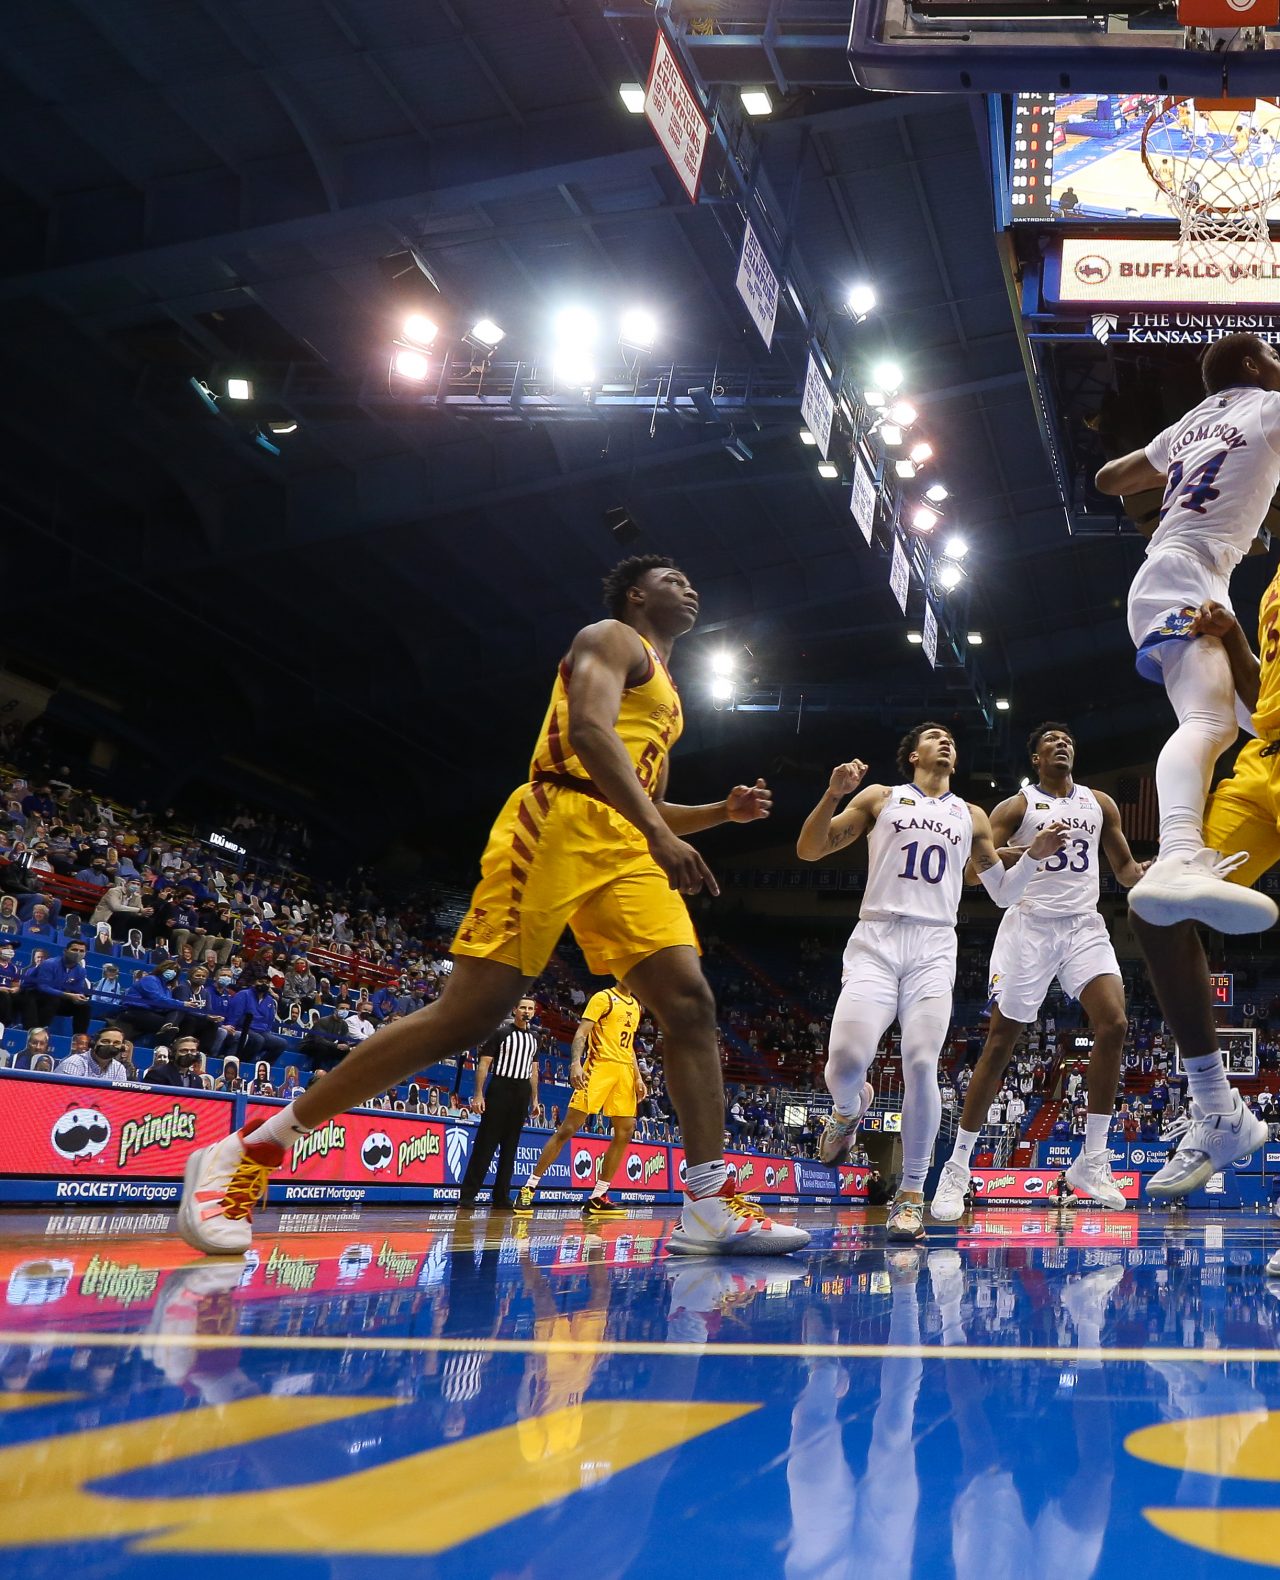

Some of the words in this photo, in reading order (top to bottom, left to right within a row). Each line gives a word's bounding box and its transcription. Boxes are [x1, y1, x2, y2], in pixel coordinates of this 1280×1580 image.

[662, 51, 678, 87] BIG
[679, 86, 701, 133] EIGHT
[656, 63, 700, 155] CHAMPIONS
[1016, 106, 1030, 116] PL
[1032, 106, 1040, 116] F
[1041, 106, 1055, 116] PT
[1014, 158, 1027, 170] 24
[1030, 158, 1036, 169] 1
[1044, 158, 1052, 170] 4
[1028, 194, 1034, 205] 1
[1119, 262, 1220, 278] BUFFALO
[1129, 312, 1169, 328] THE
[1127, 328, 1202, 344] KANSAS
[891, 817, 961, 846] KANSAS
[1035, 817, 1096, 835] KNSAS
[897, 840, 947, 885] 10
[1216, 987, 1226, 1002] 4
[619, 1031, 632, 1049] 21
[871, 1120, 880, 1129] 12
[118, 1103, 196, 1168] Pringles
[291, 1120, 346, 1173] Pringles
[397, 1129, 440, 1176] Pringles
[1049, 1146, 1071, 1155] ROCK
[644, 1151, 665, 1185] Pringles
[56, 1182, 118, 1198] ROCKET
[118, 1183, 178, 1201] Mortgage
[286, 1186, 326, 1199] ROCKET
[326, 1187, 366, 1200] Mortgage
[986, 1175, 1016, 1194] Pringles
[540, 1191, 561, 1200] ROCKET
[561, 1192, 584, 1201] Mortgage
[621, 1192, 638, 1200] ROCKET
[638, 1193, 655, 1202] Mortgage
